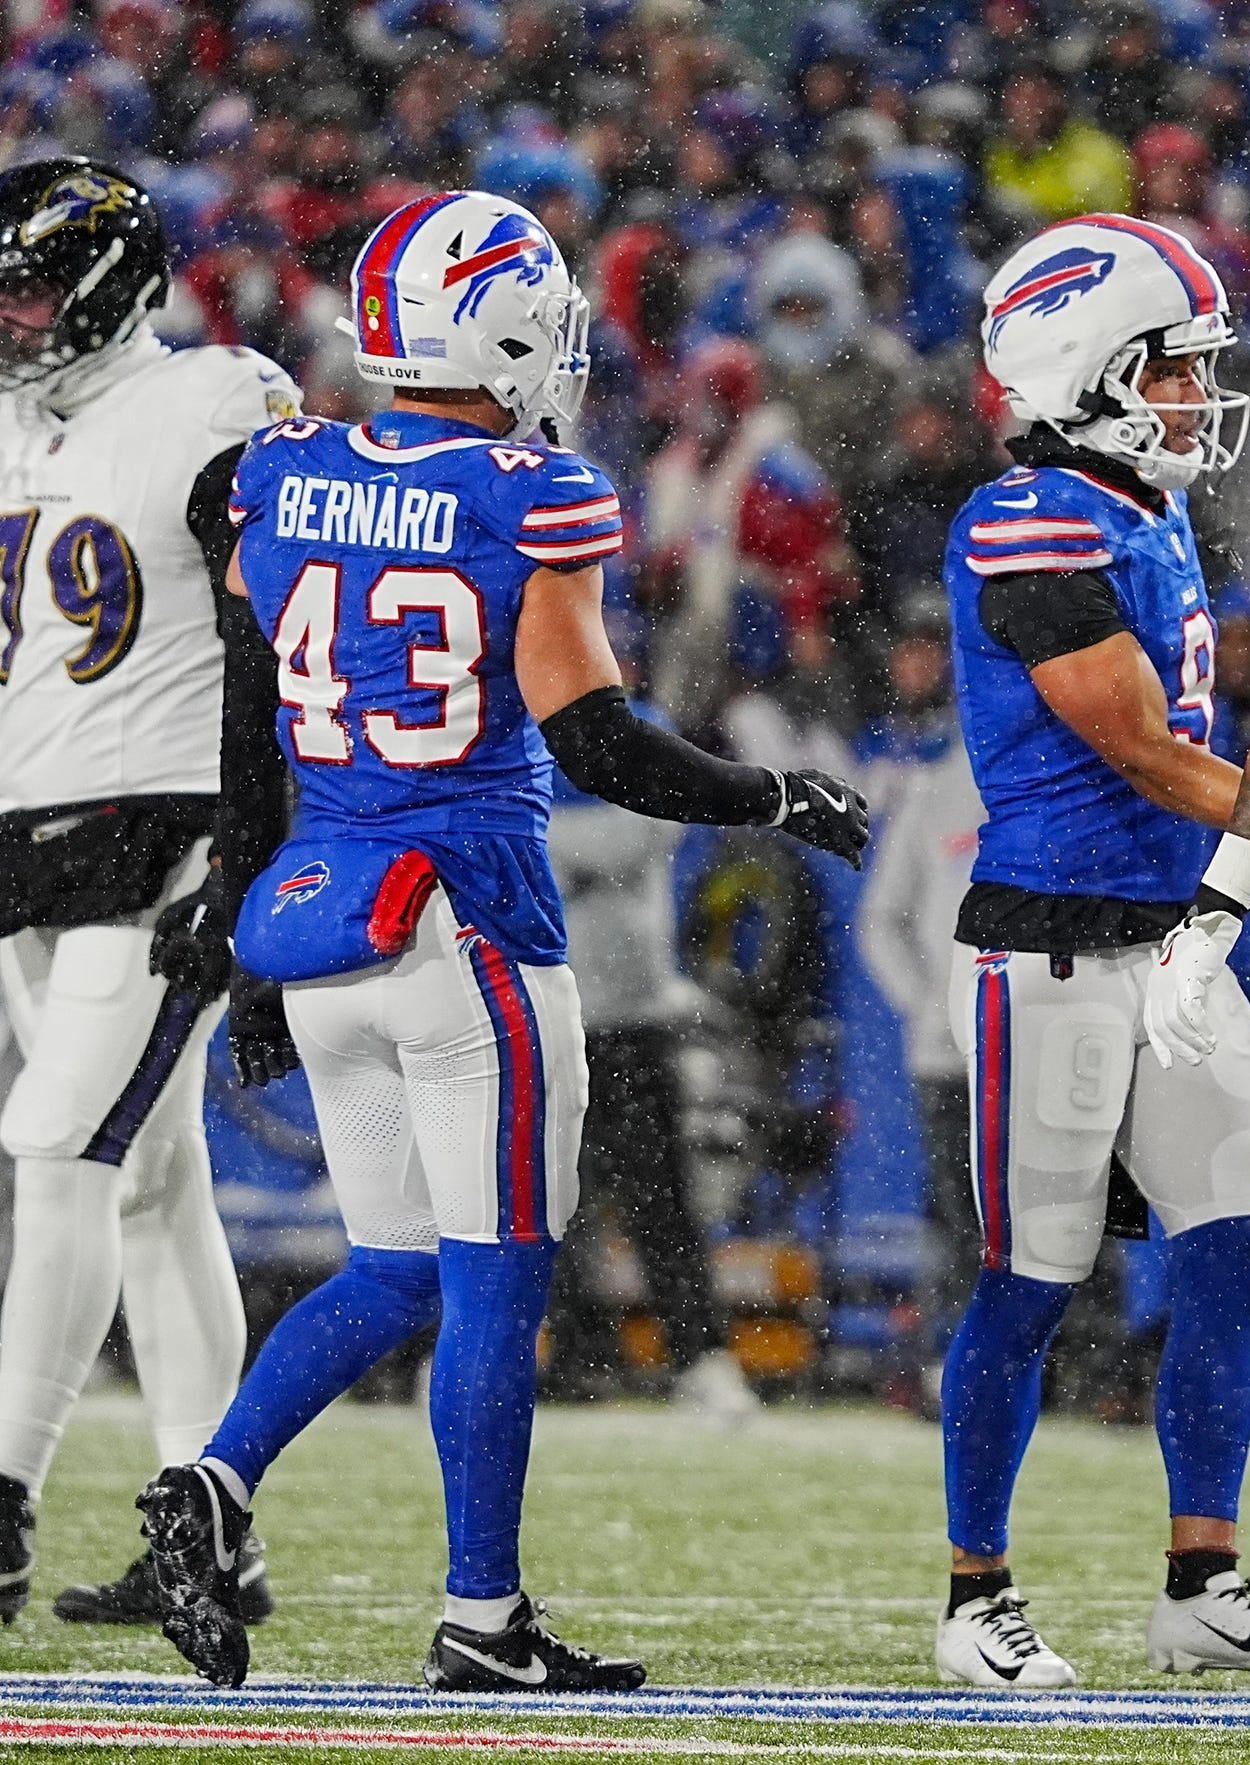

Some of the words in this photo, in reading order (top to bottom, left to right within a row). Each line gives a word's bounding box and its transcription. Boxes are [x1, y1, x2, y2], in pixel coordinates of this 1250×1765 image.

[388, 367, 421, 379] LOVE
[276, 476, 459, 554] BERNARD
[0, 506, 144, 686] 79
[273, 560, 486, 769] 43
[1172, 606, 1216, 752] 9
